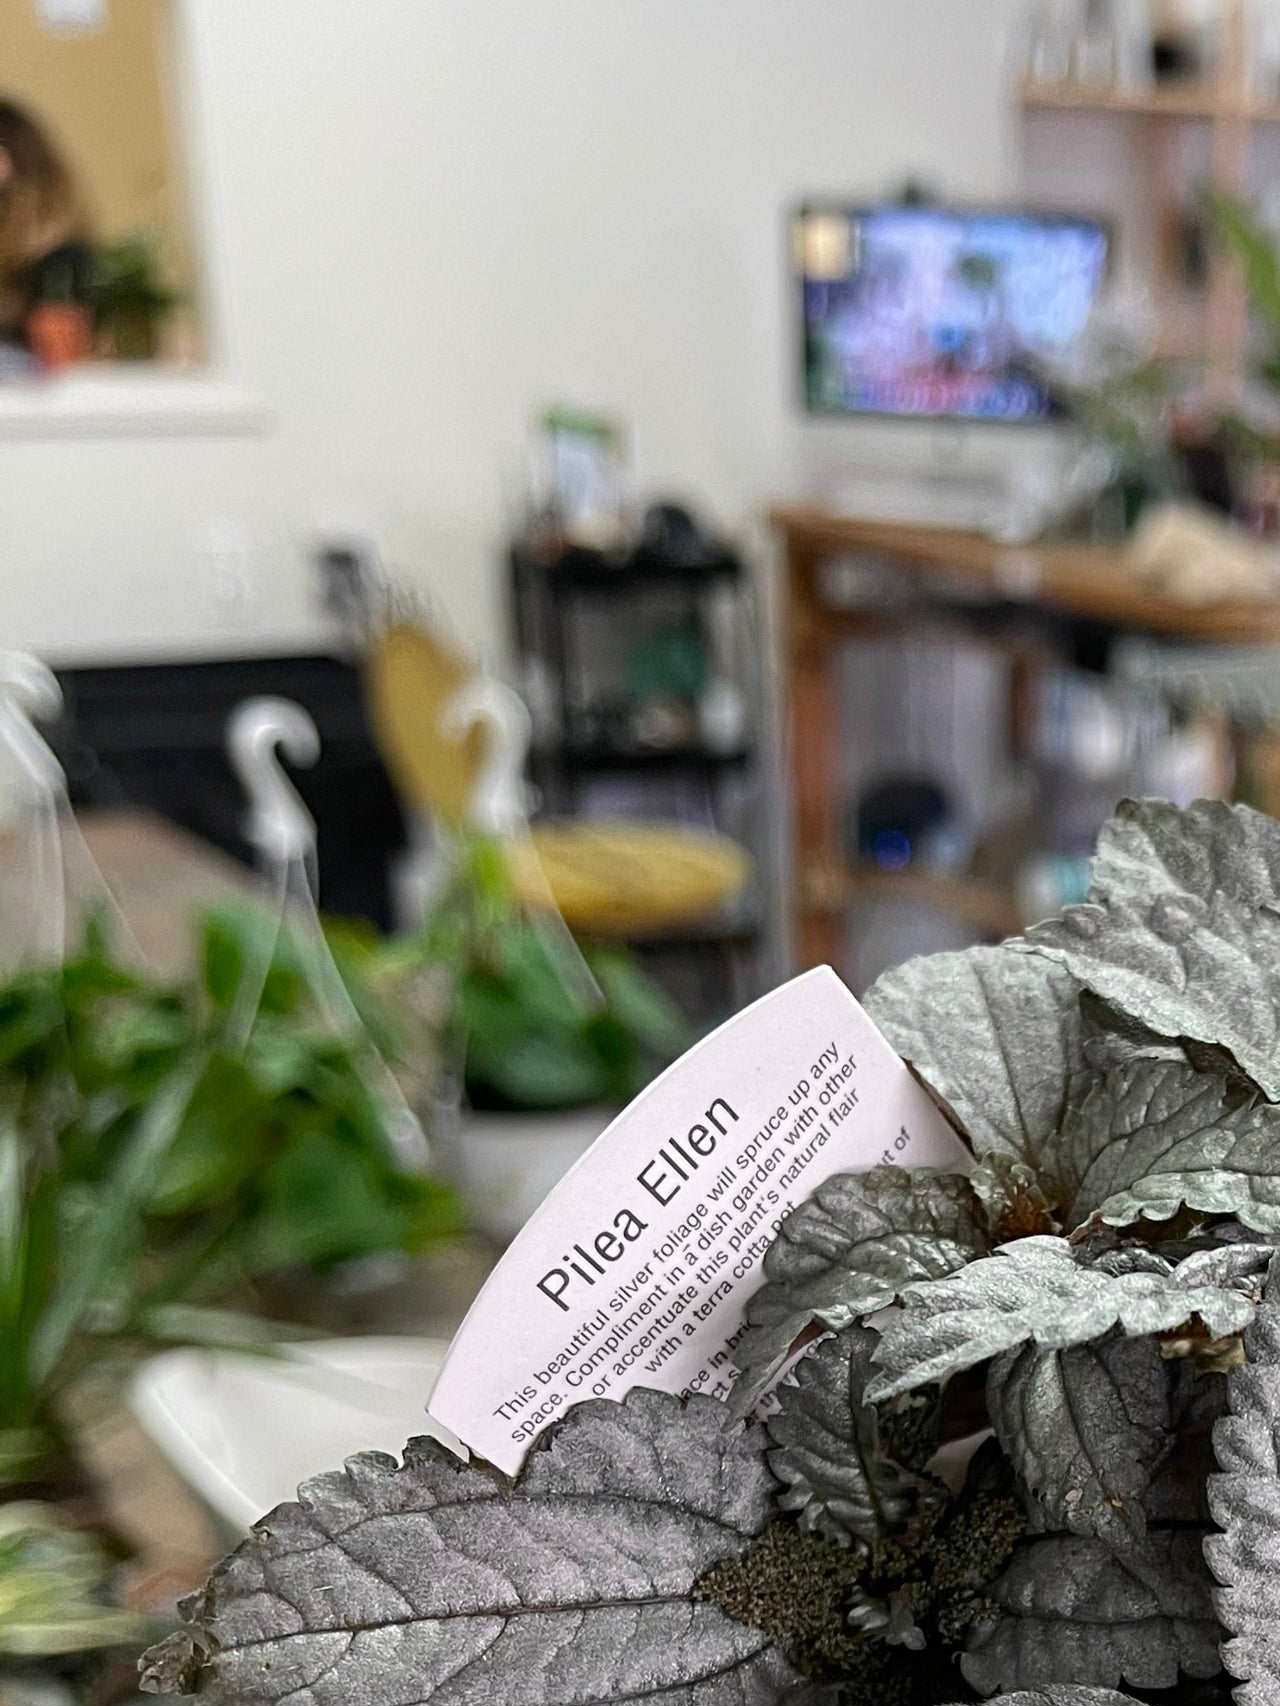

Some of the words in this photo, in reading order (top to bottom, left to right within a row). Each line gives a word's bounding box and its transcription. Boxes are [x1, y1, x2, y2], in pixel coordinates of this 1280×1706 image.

[493, 1386, 537, 1420] This
[533, 1309, 610, 1384] beautiful
[610, 1263, 653, 1312] silver
[653, 1204, 708, 1263] foliage
[707, 1166, 737, 1201] will
[736, 1106, 788, 1169] spruce
[788, 1080, 810, 1104] up
[811, 1041, 839, 1079] any
[511, 1392, 568, 1442] space.
[566, 1284, 667, 1387] Compliment
[666, 1266, 685, 1285] in
[698, 1211, 732, 1250] dish
[732, 1147, 785, 1212] garden
[784, 1106, 819, 1145] with
[819, 1055, 857, 1105] other
[537, 1209, 649, 1312] Pilea
[637, 1098, 739, 1206] Ellen
[592, 1375, 612, 1396] or
[613, 1286, 698, 1376] accentuate
[696, 1251, 729, 1284] this
[728, 1190, 779, 1252] plant's
[779, 1124, 831, 1189] natural
[829, 1088, 859, 1127] flair
[645, 1336, 682, 1373] with
[682, 1323, 696, 1336] a
[693, 1280, 733, 1321] terra
[733, 1235, 773, 1279] cotta
[708, 1351, 728, 1369] in
[894, 1125, 911, 1151] of
